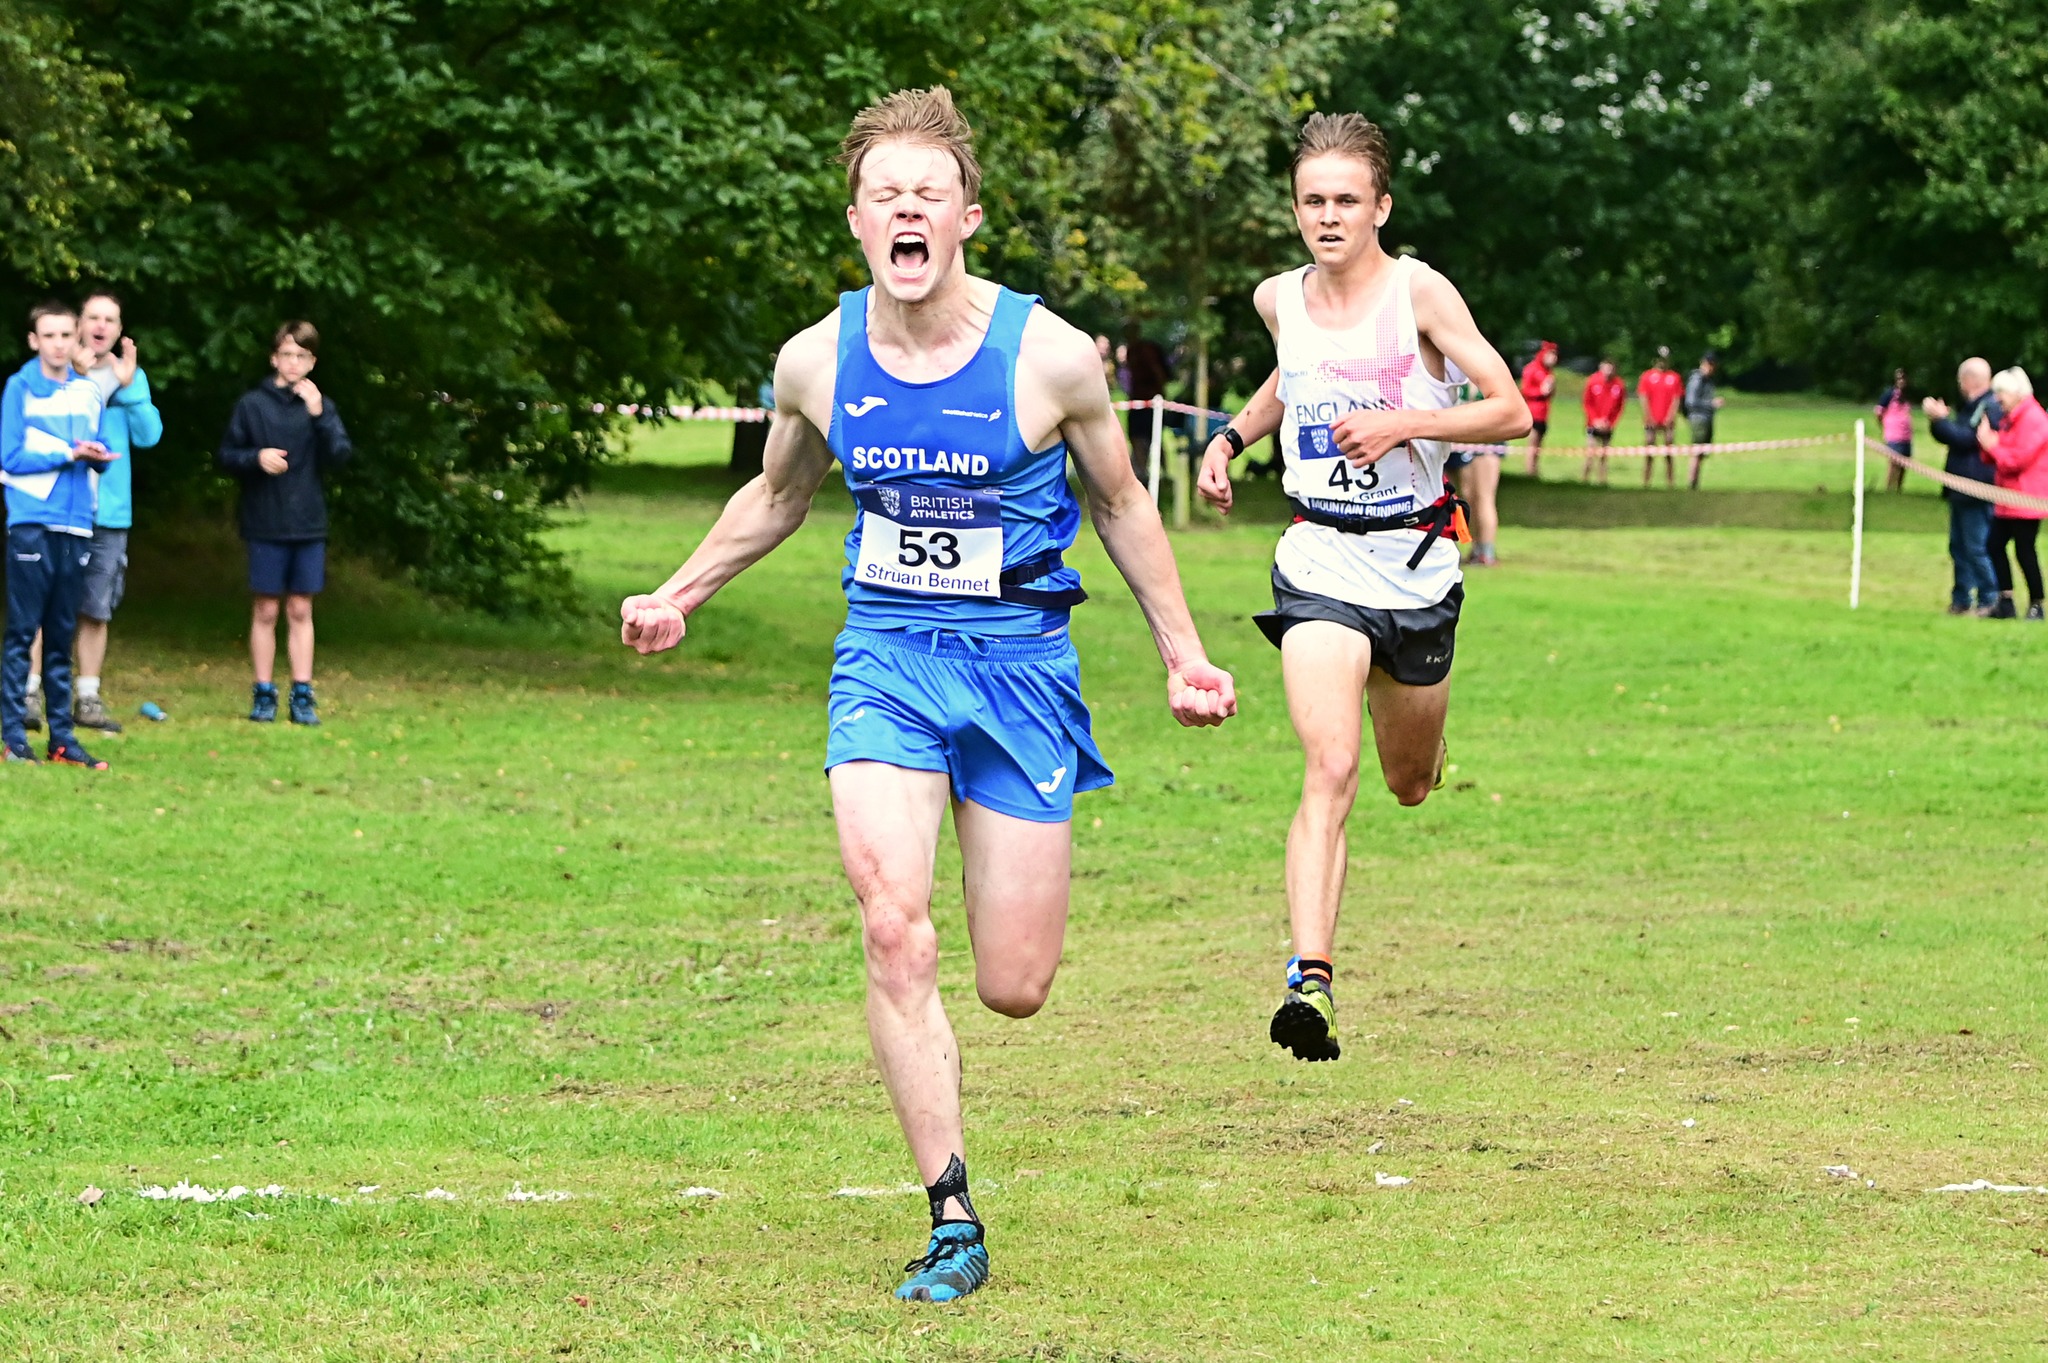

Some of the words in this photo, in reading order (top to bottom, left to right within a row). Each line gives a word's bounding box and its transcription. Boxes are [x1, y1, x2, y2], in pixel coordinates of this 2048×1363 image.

[1296, 400, 1394, 425] ENGLA
[852, 446, 989, 476] SCOTLAND
[1328, 459, 1379, 493] 43
[910, 495, 973, 509] BRITISH
[1359, 485, 1398, 501] Grant
[910, 509, 975, 520] ATHLETICS
[1311, 499, 1364, 516] MOUNTAIN
[1365, 501, 1412, 518] RUNNING
[898, 529, 961, 570] 53
[865, 563, 922, 586] Struan
[929, 572, 990, 592] Bennet
